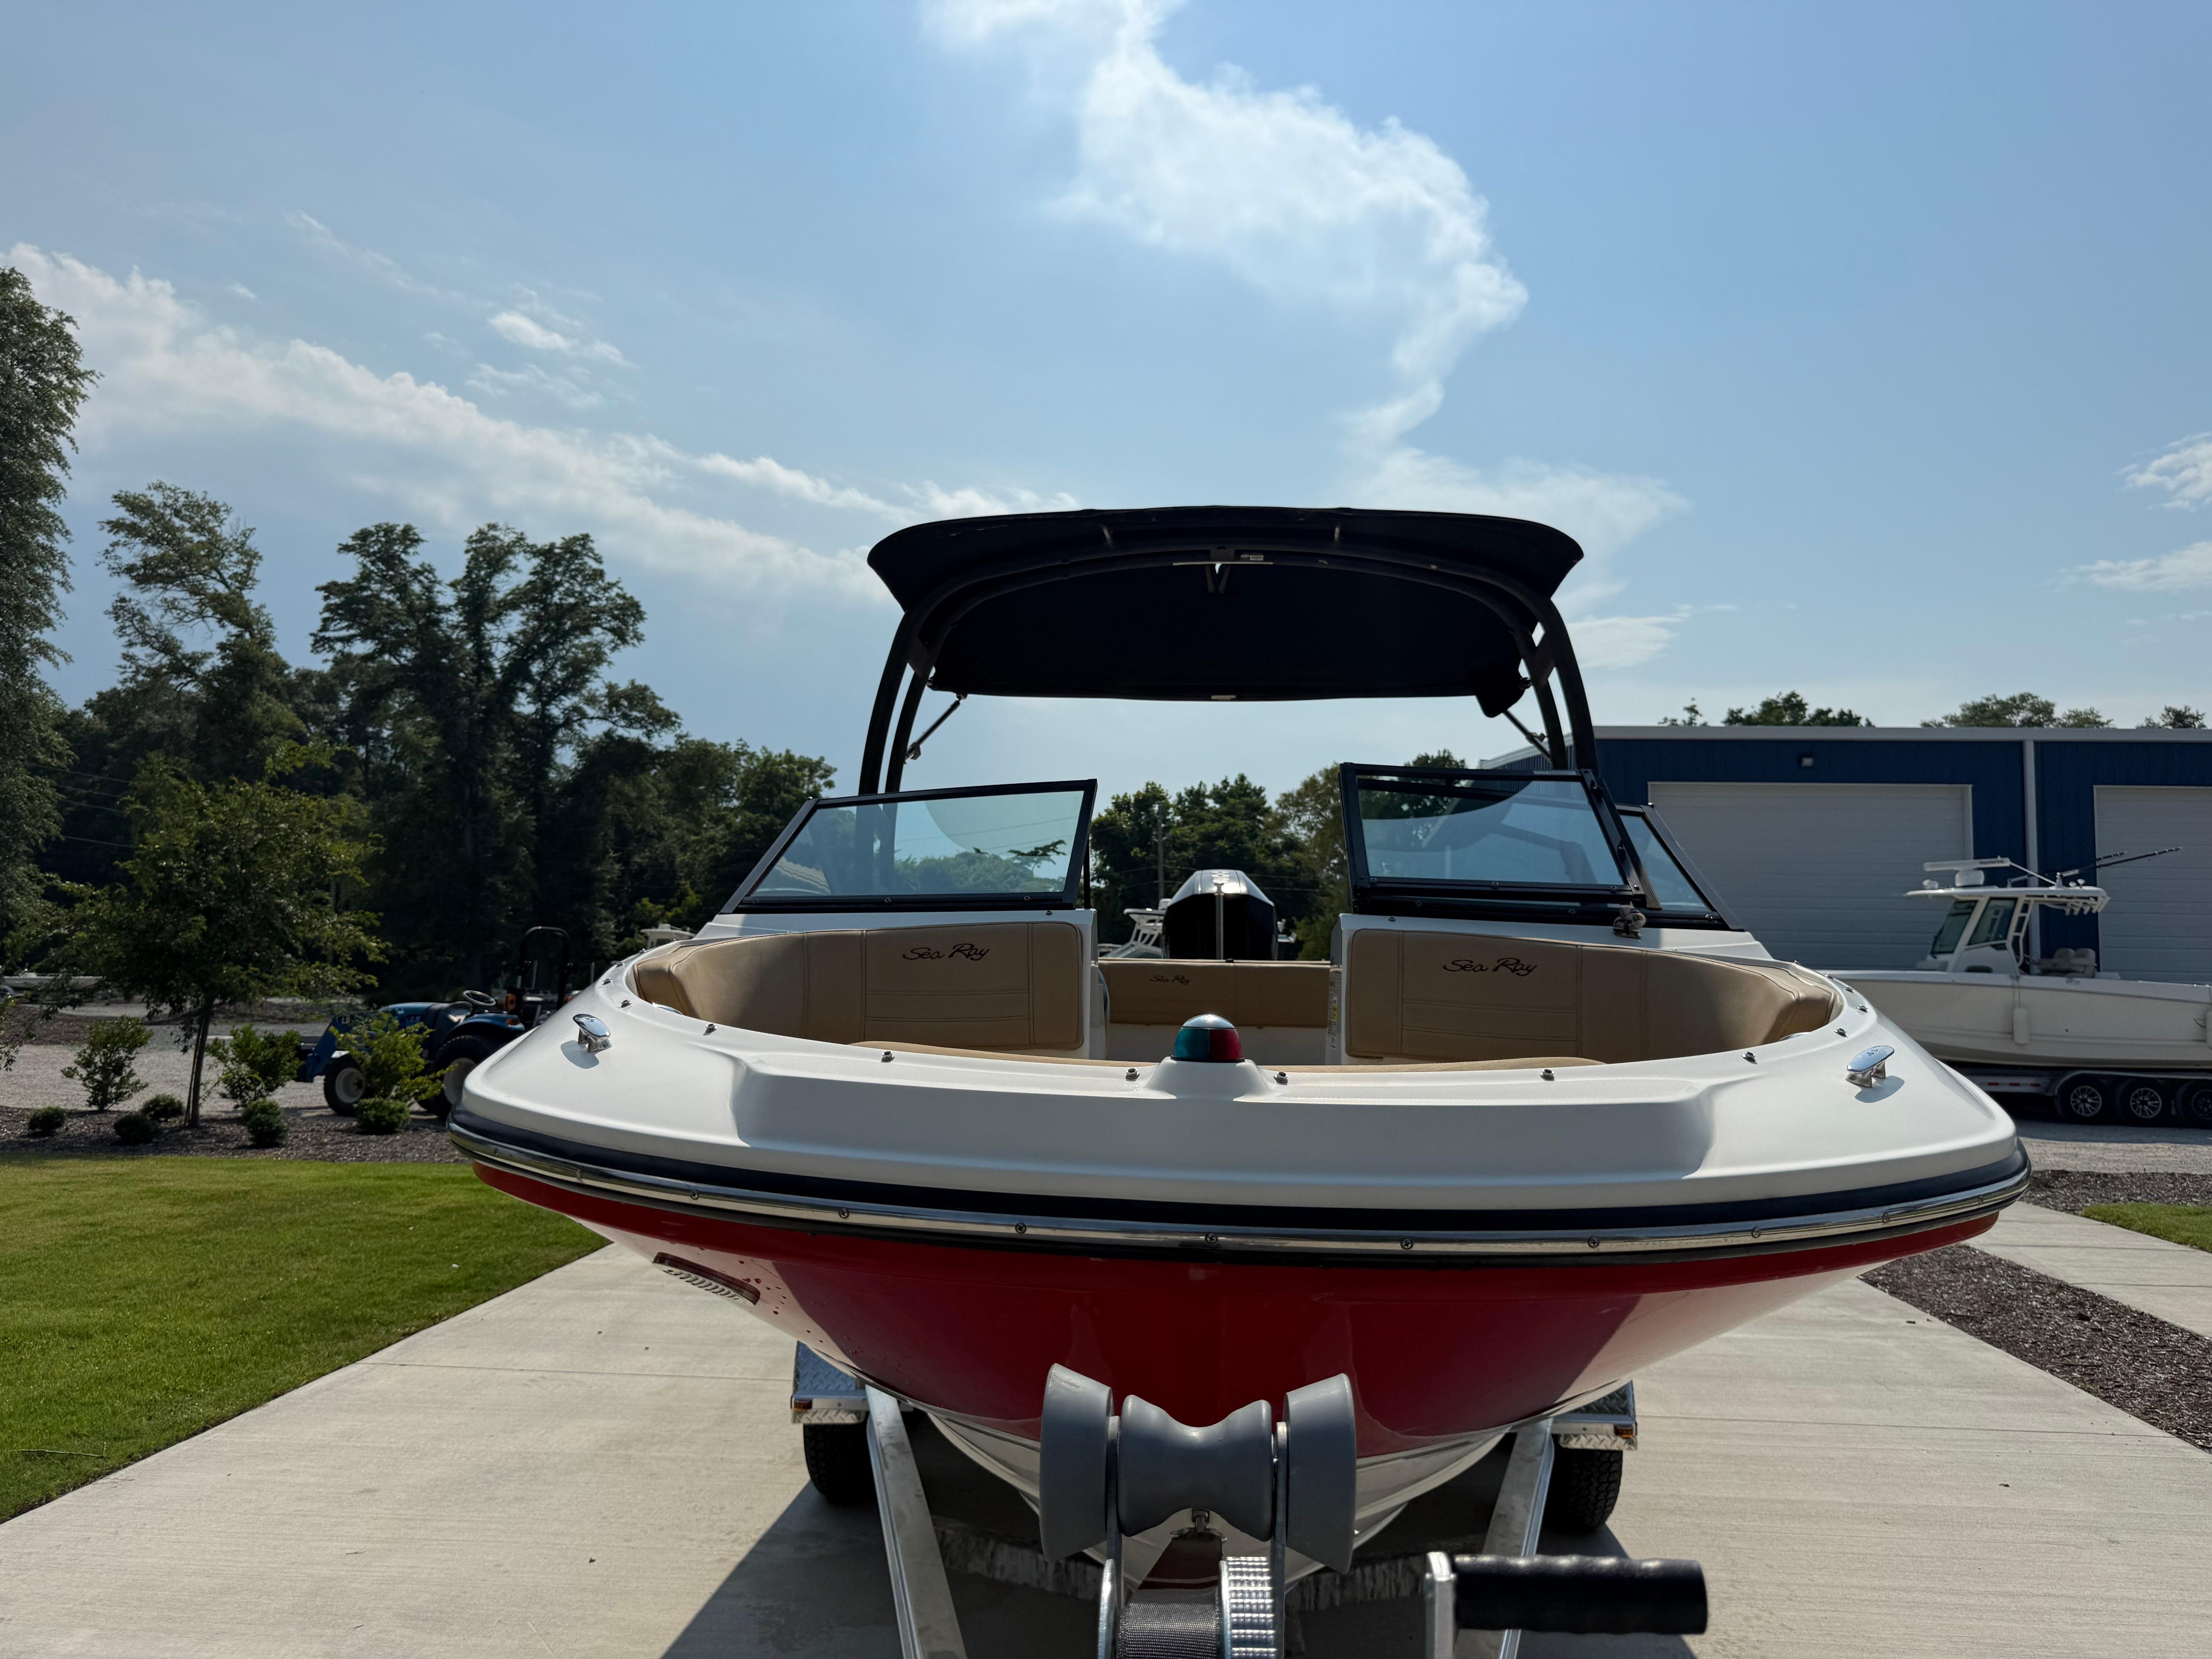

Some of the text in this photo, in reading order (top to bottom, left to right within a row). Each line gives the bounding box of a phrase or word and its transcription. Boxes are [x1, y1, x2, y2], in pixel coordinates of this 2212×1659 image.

[902, 943, 990, 961] Sea Ray
[1443, 958, 1537, 977] Sea Ray
